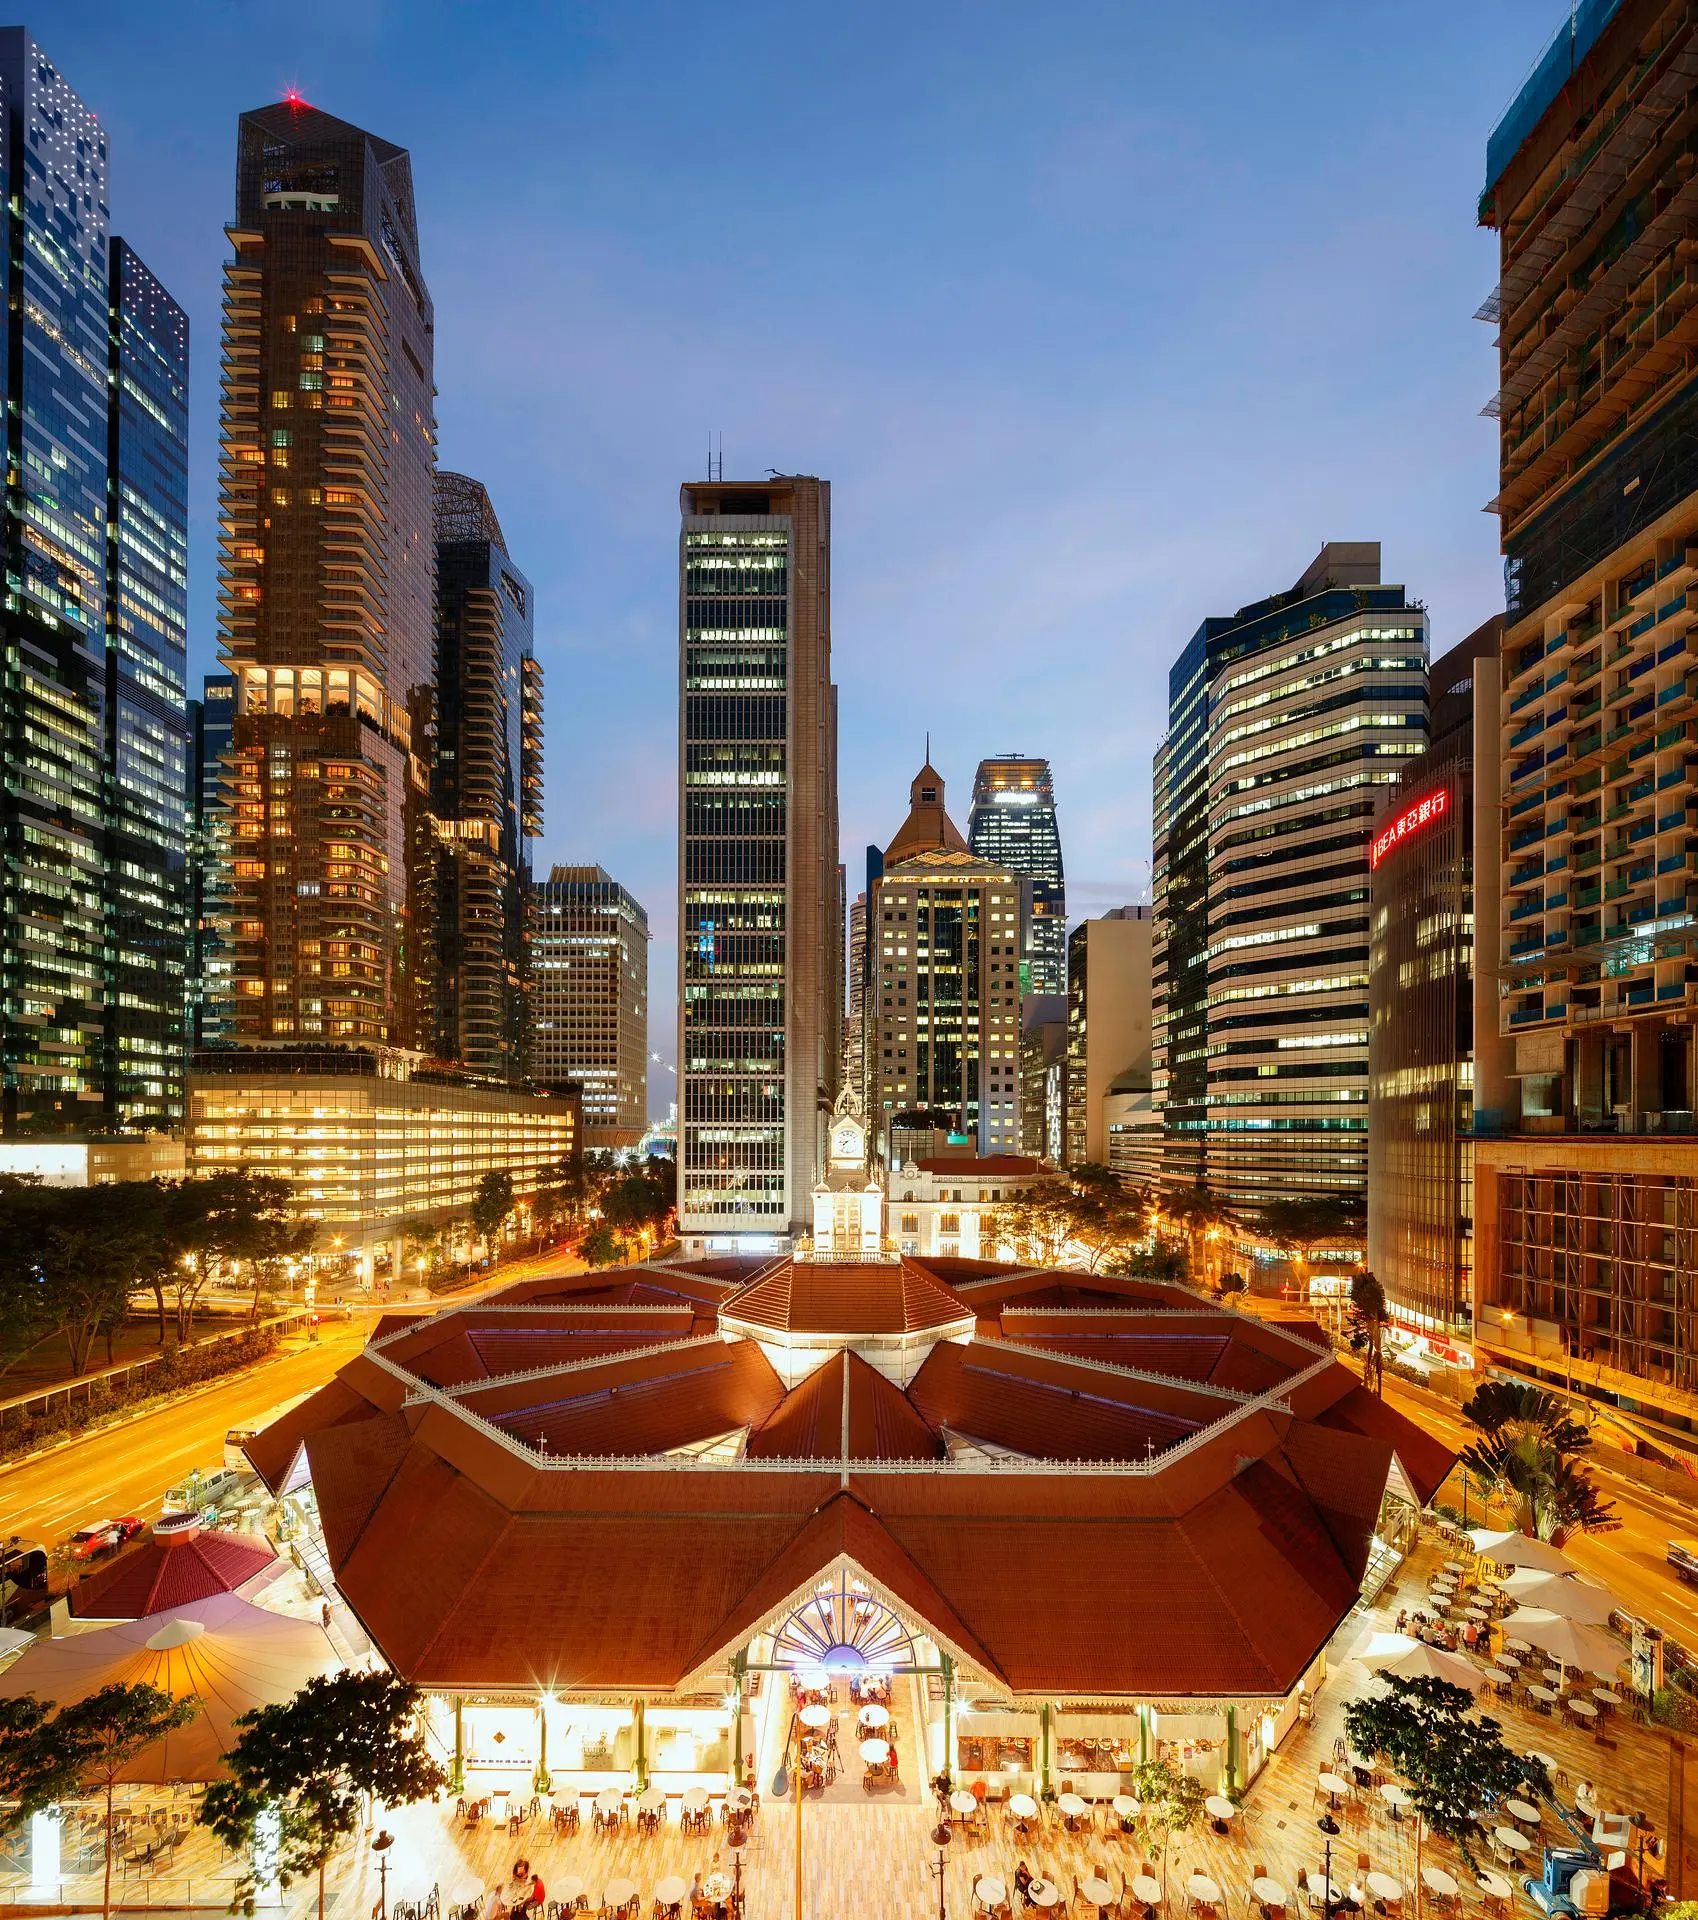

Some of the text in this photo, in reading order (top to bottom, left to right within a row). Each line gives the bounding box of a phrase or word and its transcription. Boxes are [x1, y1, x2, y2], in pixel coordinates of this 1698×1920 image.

[1378, 791, 1445, 857] BEA 東亞銀行
